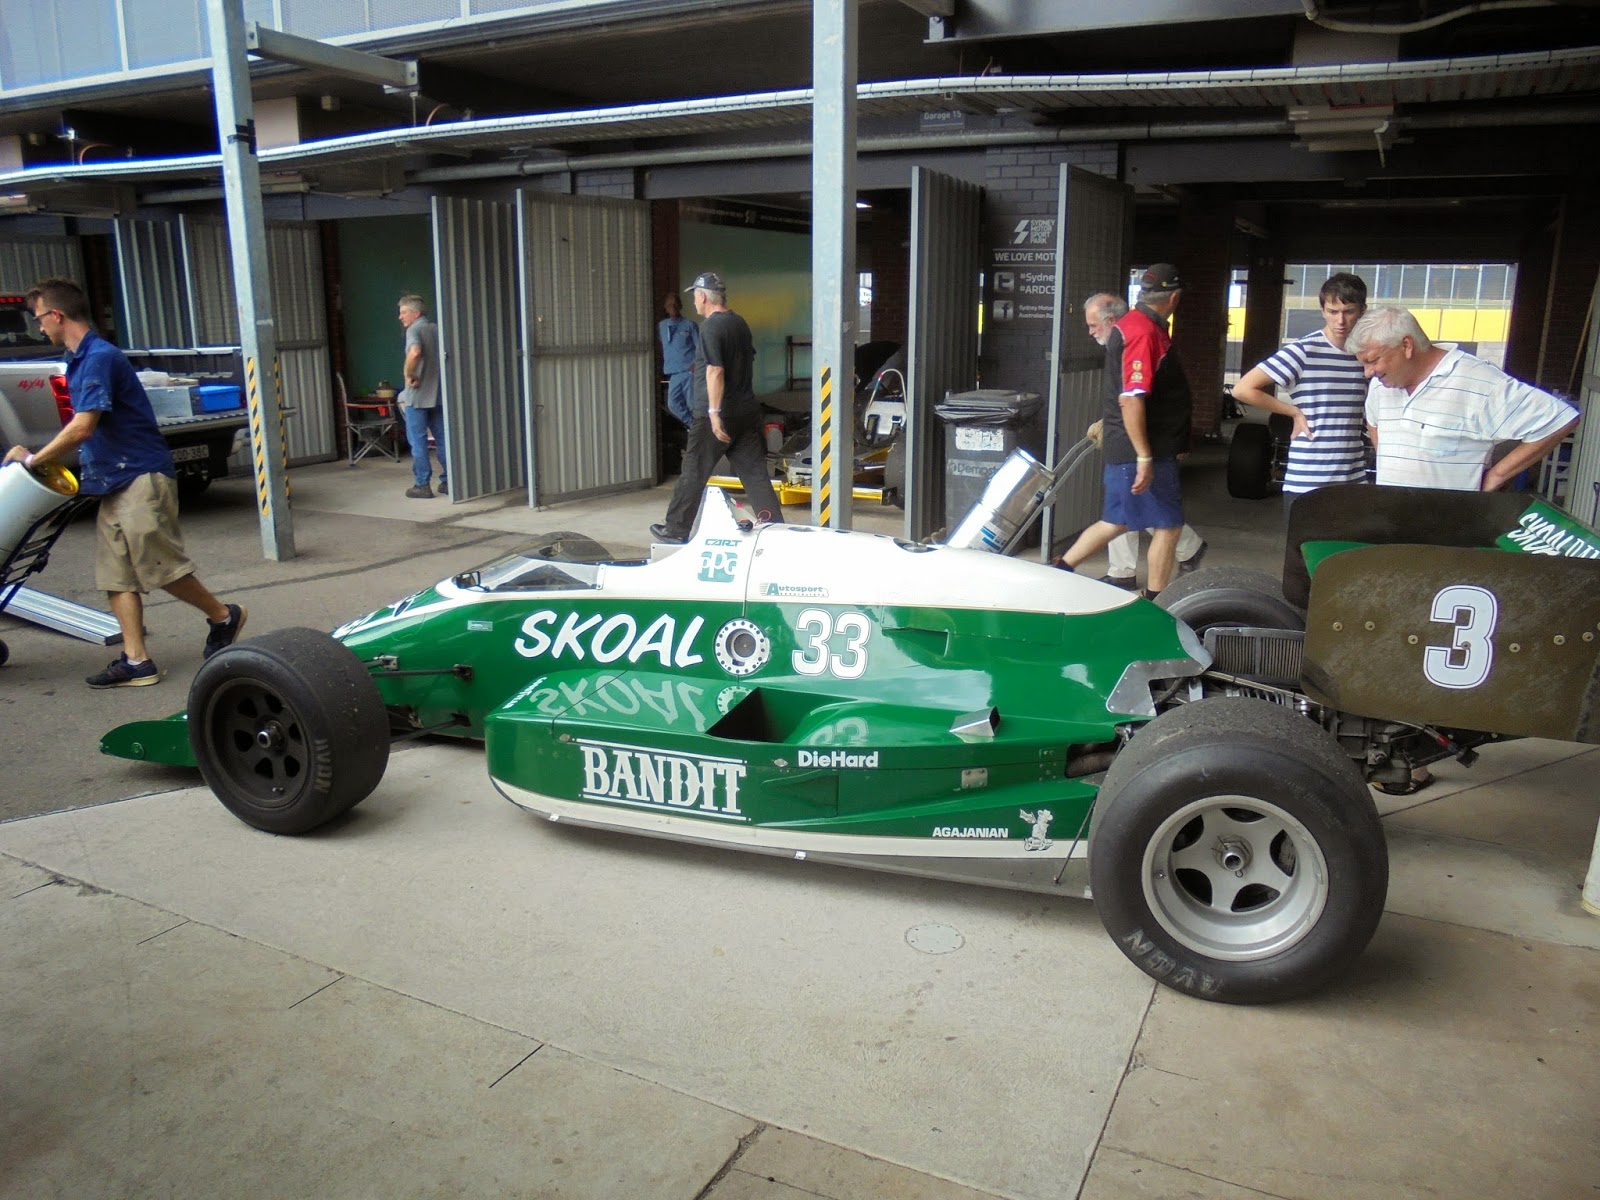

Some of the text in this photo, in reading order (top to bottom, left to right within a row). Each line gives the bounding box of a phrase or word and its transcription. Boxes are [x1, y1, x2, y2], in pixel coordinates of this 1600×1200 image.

[924, 112, 950, 120] Garage
[995, 253, 1057, 261] WE LOVE MOT
[704, 538, 742, 547] CART
[766, 582, 823, 596] Autosport
[514, 610, 705, 668] SKOAL
[792, 608, 871, 680] 33
[1423, 585, 1498, 689] 3
[798, 750, 879, 768] DieHard
[580, 745, 748, 814] BANDIT
[932, 827, 1009, 839] AGAJANIAN
